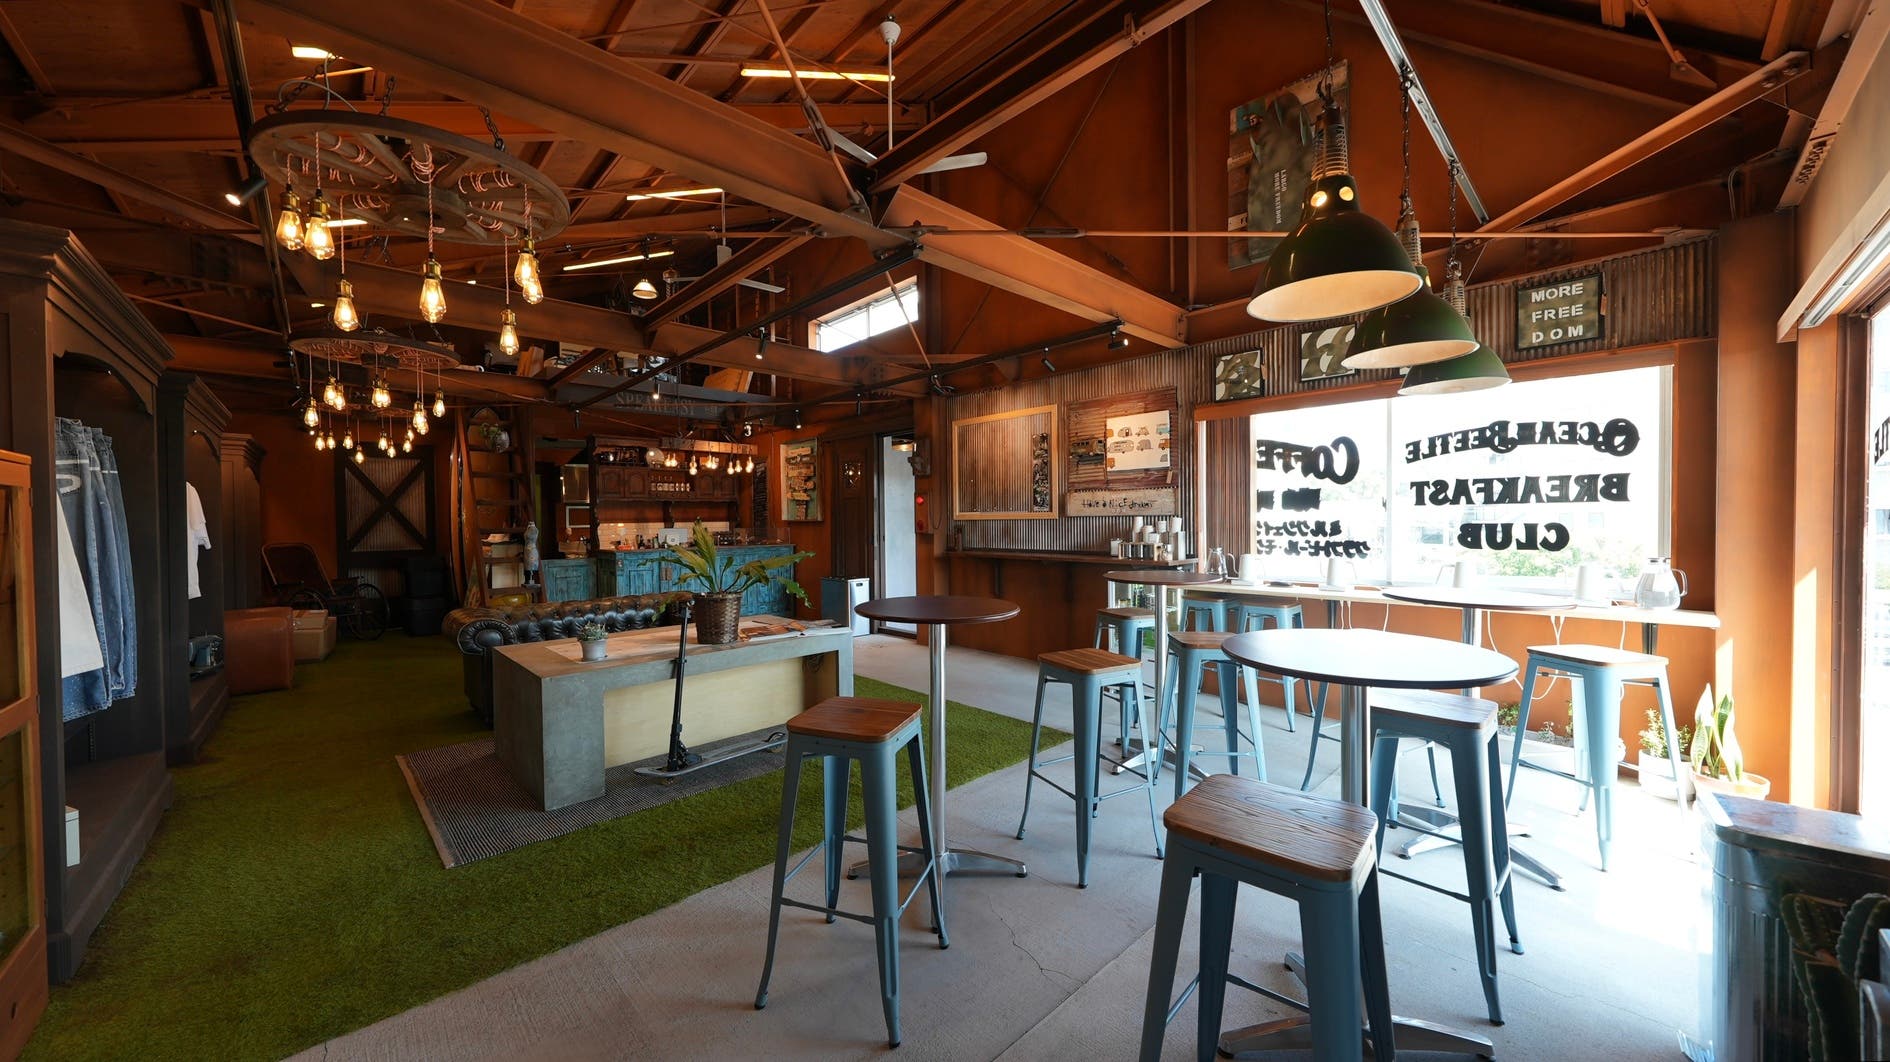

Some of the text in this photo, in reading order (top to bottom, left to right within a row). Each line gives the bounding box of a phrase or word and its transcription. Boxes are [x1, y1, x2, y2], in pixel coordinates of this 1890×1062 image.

[1274, 192, 1282, 225] FREEDOM
[1531, 282, 1584, 303] MORE
[1531, 303, 1584, 323] FREE
